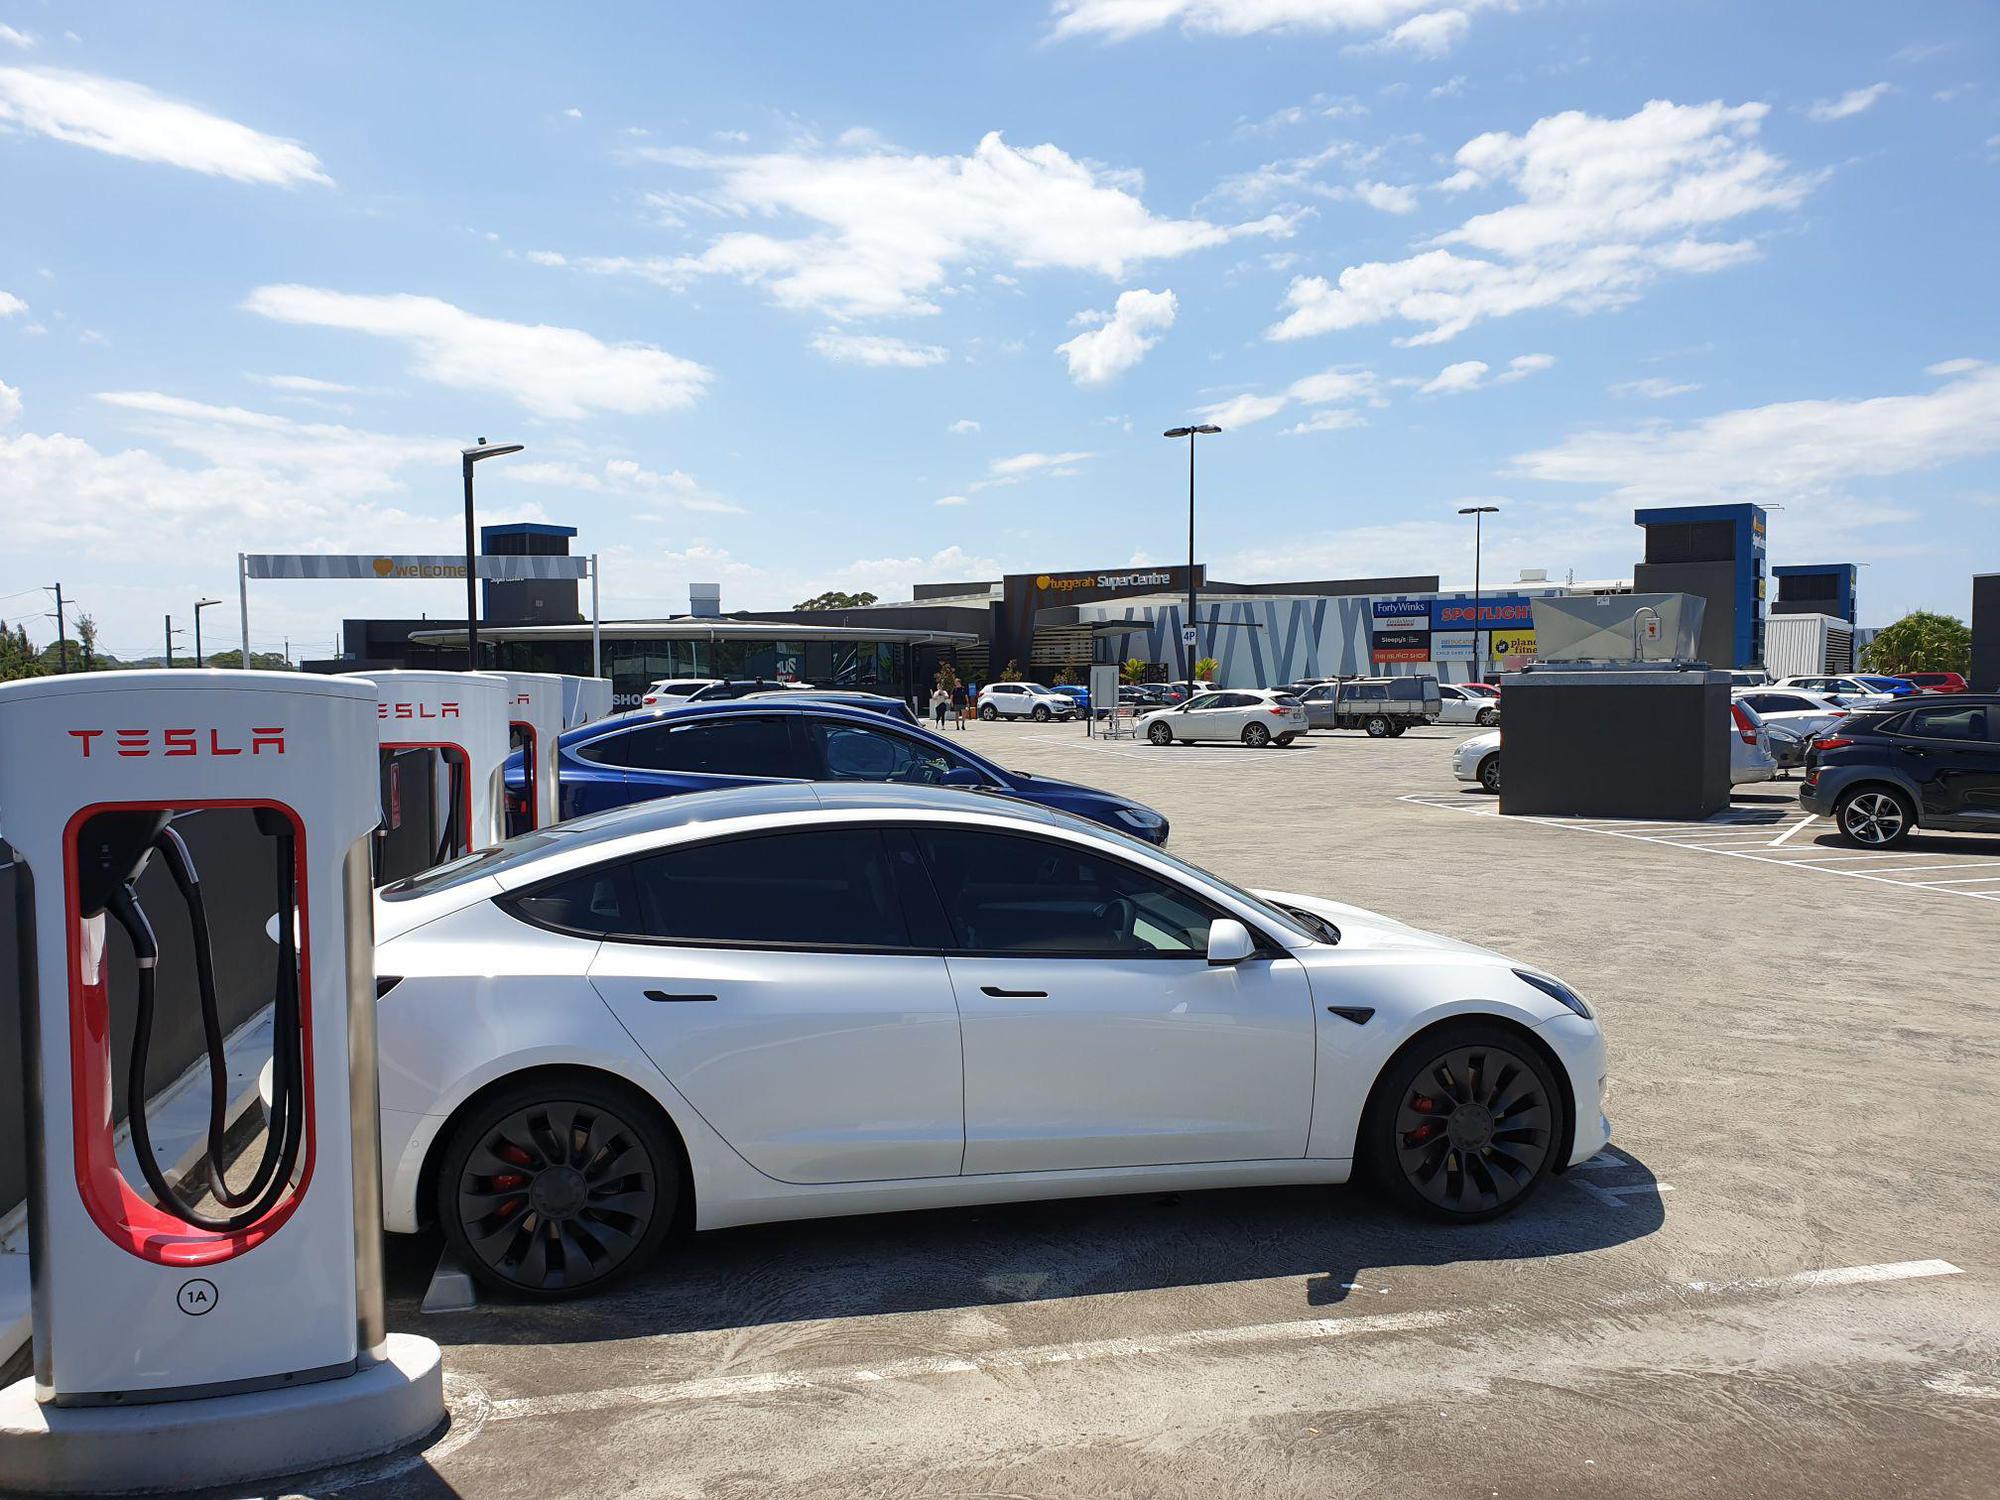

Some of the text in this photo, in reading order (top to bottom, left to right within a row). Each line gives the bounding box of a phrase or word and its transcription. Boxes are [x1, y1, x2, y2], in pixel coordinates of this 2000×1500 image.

[395, 563, 467, 577] welcome
[1050, 572, 1171, 592] tuggerah SuperCentre
[1377, 601, 1425, 614] Forty Winks
[1510, 638, 1537, 648] plan
[1514, 646, 1538, 654] fitne
[613, 694, 642, 705] SHO
[378, 702, 459, 718] ESLA
[67, 727, 285, 758] TESLA
[187, 1290, 207, 1303] 1A
